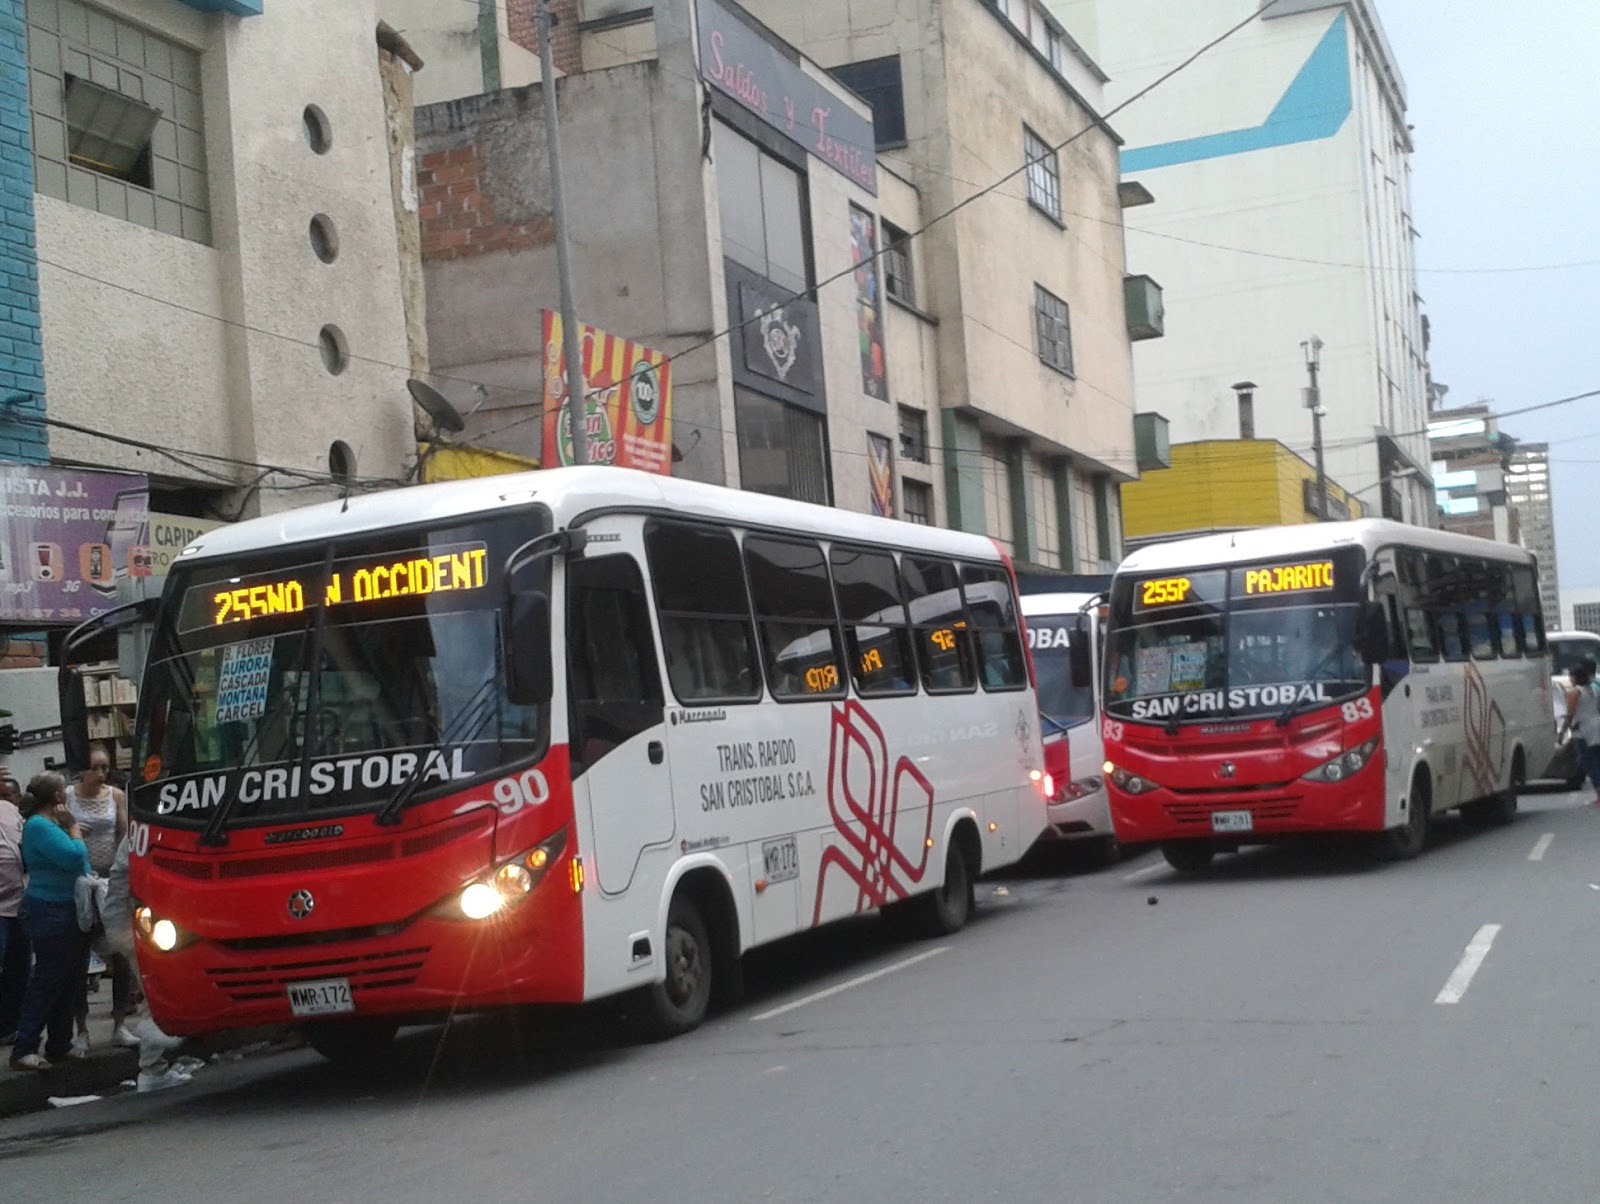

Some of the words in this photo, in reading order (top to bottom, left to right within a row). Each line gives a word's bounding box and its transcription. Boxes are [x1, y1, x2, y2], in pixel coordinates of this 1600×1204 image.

[709, 31, 767, 113] Saldos
[784, 96, 794, 130] y
[56, 480, 88, 498] J.J.
[63, 507, 90, 523] para
[353, 549, 487, 602] OCCIDENT
[1143, 578, 1191, 604] 255P
[1246, 562, 1334, 594] PAJARITO
[236, 639, 273, 658] FLORES
[223, 655, 269, 676] AURORA
[220, 671, 268, 692] CASCADA
[216, 702, 263, 722] CARCEL
[1132, 696, 1180, 719] SAN
[1183, 683, 1333, 714] CRISTOBAL
[1341, 698, 1374, 723] 83
[1103, 720, 1124, 742] 83
[717, 742, 758, 772] TRANS.
[758, 738, 796, 767] RAPIDO
[159, 775, 227, 815] SAN
[239, 748, 476, 803] CRISTOBAL
[494, 769, 549, 815] 90
[700, 781, 726, 812] SAN
[728, 774, 785, 807] CRISTOBAL
[788, 770, 816, 798] S.C.A.
